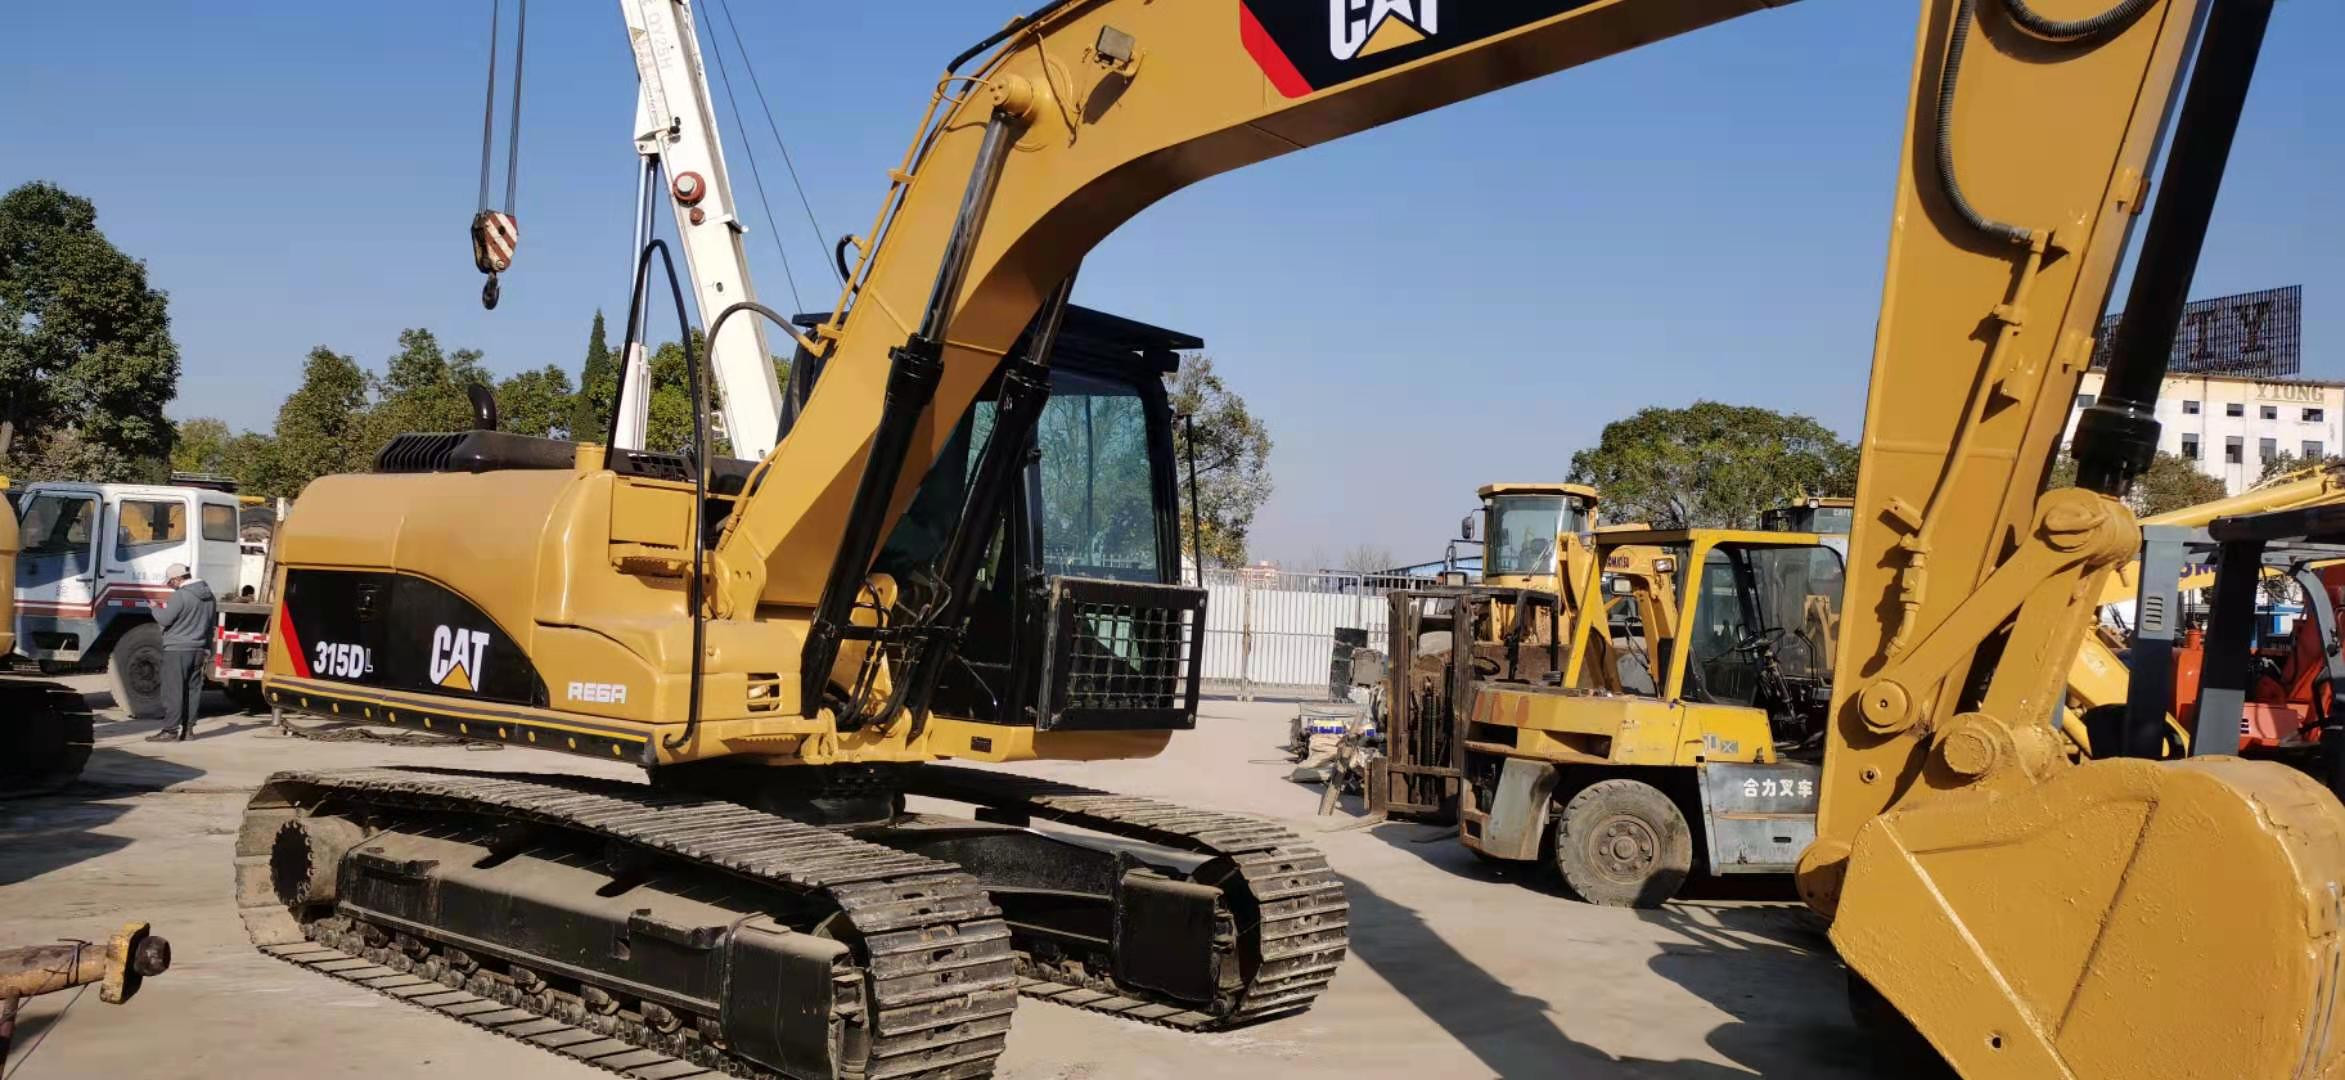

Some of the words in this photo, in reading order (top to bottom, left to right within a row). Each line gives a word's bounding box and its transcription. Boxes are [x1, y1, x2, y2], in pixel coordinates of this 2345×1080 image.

[2256, 382, 2324, 402] YTONG
[430, 624, 490, 692] CAT
[1743, 778, 1813, 798] 合力叉车
